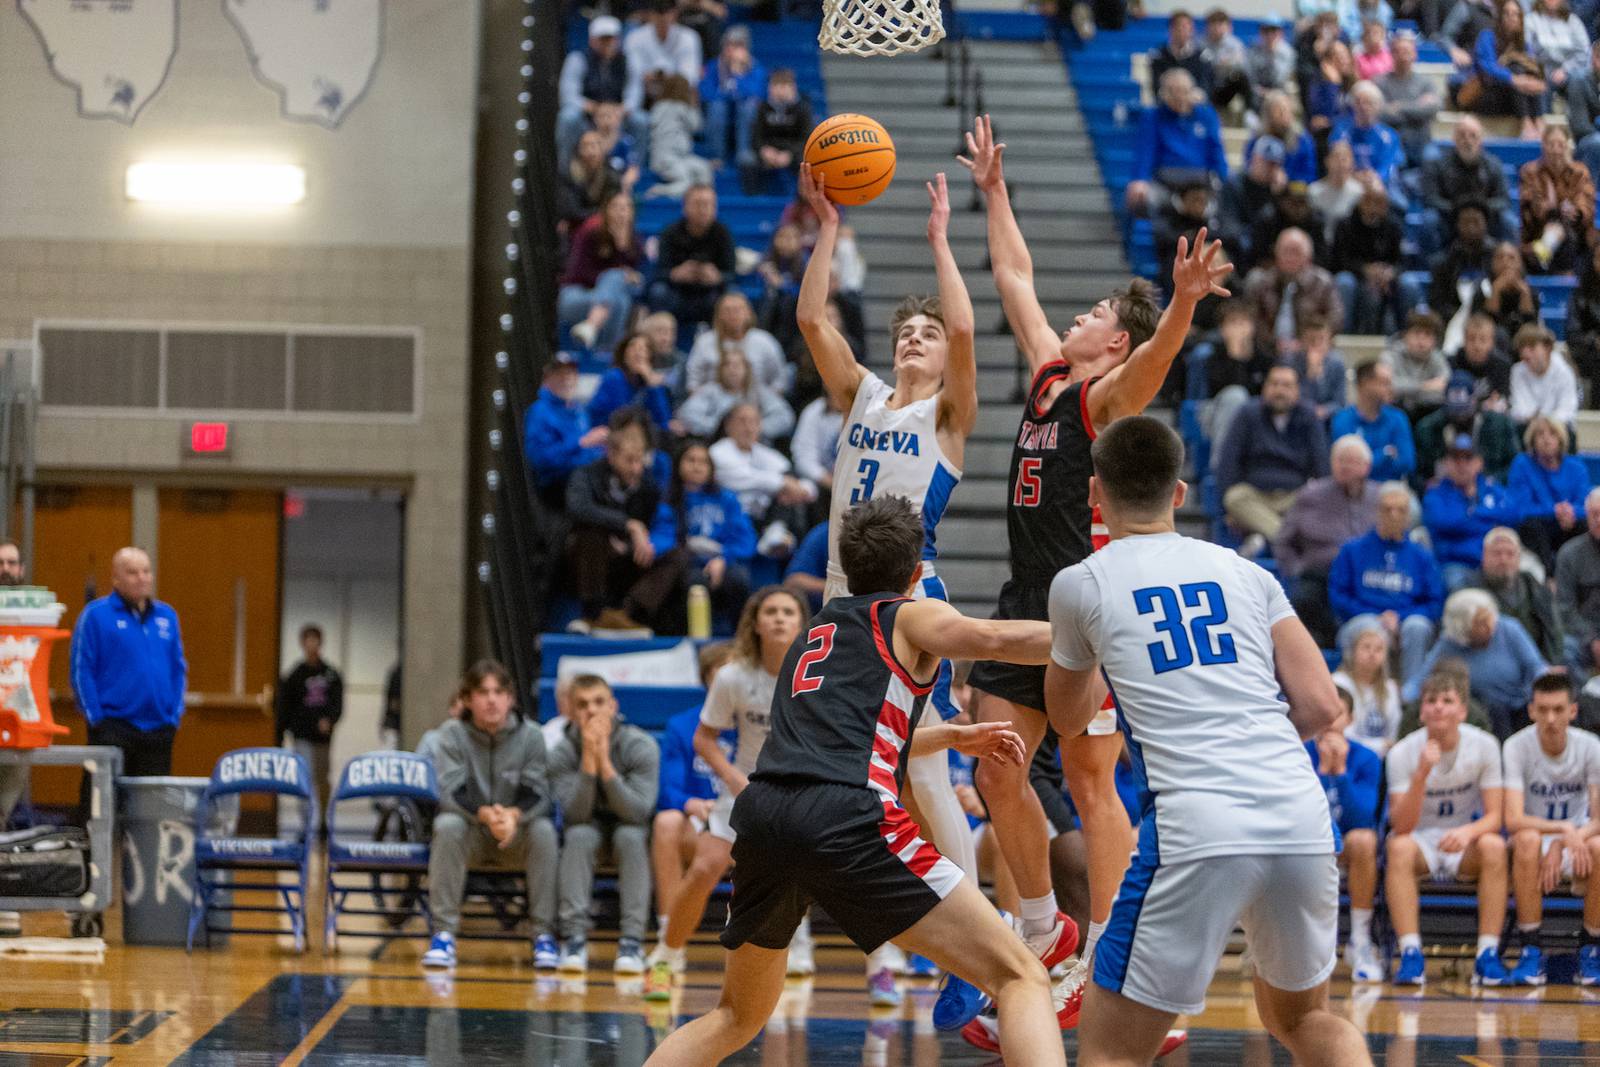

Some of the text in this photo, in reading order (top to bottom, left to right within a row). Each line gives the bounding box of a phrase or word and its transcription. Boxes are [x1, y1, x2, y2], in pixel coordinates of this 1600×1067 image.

[819, 129, 880, 149] Wilson
[849, 458, 880, 506] 3
[1013, 457, 1042, 507] 15
[1132, 581, 1238, 675] 32
[791, 622, 838, 698] 2
[220, 752, 298, 785] GENEVA
[348, 758, 428, 790] GENEVA
[210, 839, 274, 856] VIKINGS
[347, 842, 413, 858] VIKINGS
